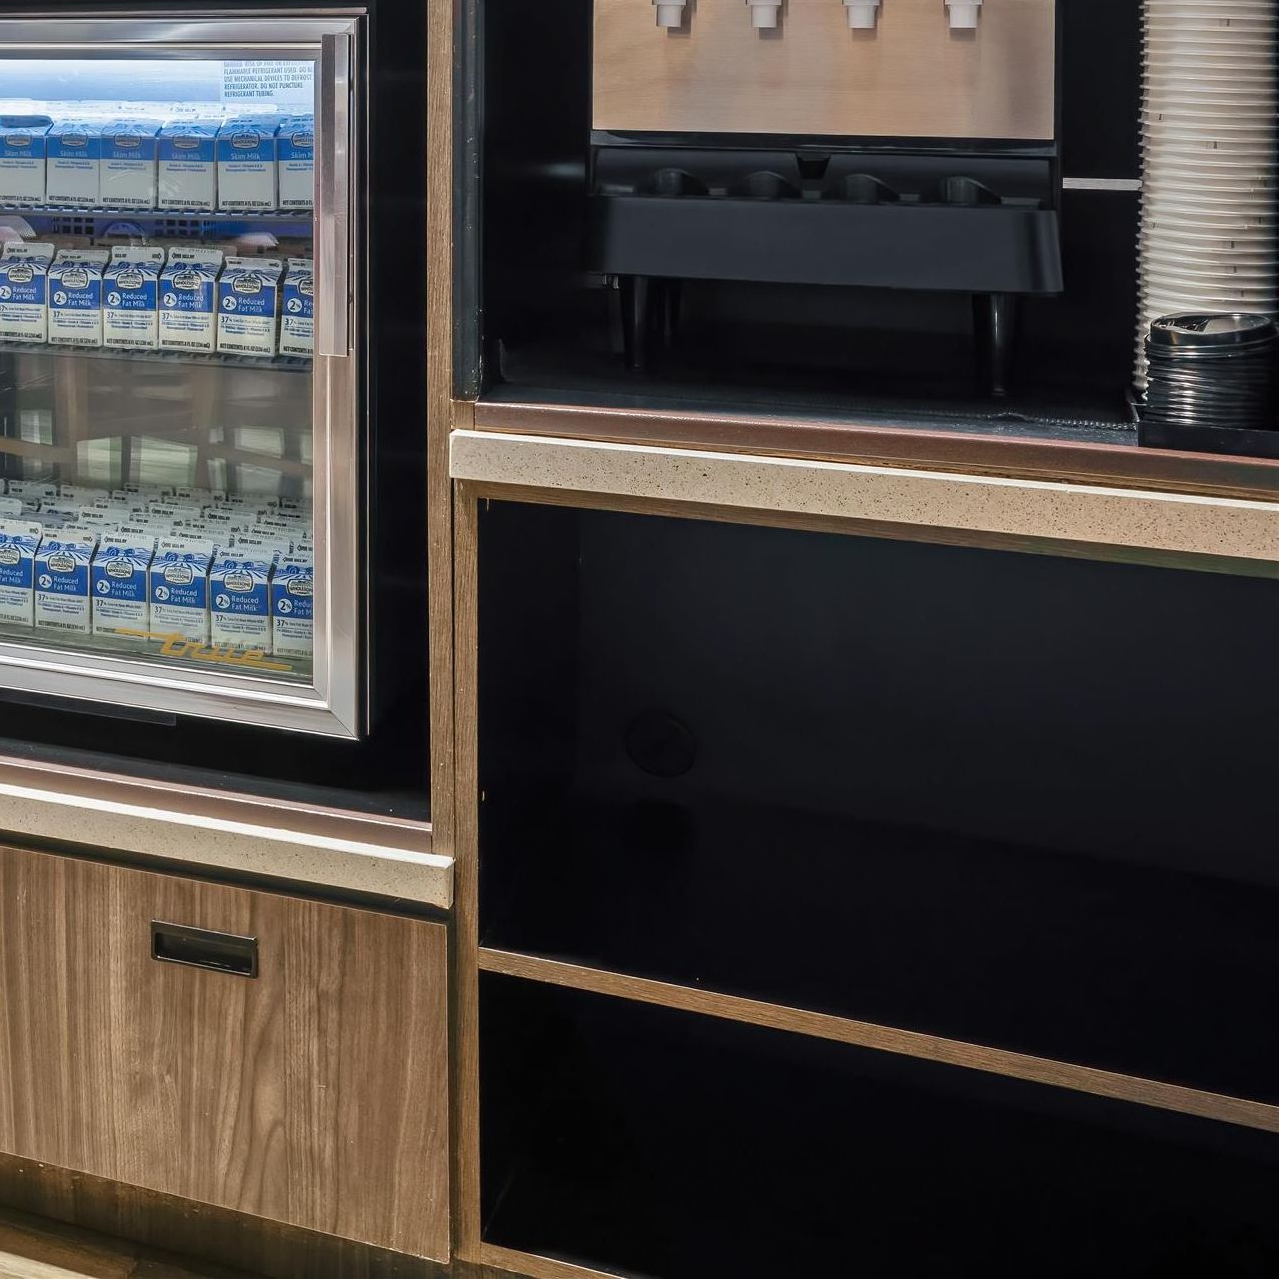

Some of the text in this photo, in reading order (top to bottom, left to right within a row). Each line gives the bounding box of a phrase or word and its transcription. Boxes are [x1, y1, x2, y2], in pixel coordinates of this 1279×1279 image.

[13, 286, 37, 294] Reduced
[68, 292, 93, 300] Reduced
[122, 292, 148, 300] Reduced
[178, 293, 204, 301] Reduced
[238, 297, 265, 305] Reduced
[54, 576, 78, 585] Reduced
[112, 581, 137, 590] Reduced
[171, 587, 198, 596] Reduced
[182, 596, 195, 604] Milk
[231, 595, 259, 604] Reduced
[243, 604, 257, 612] Milk
